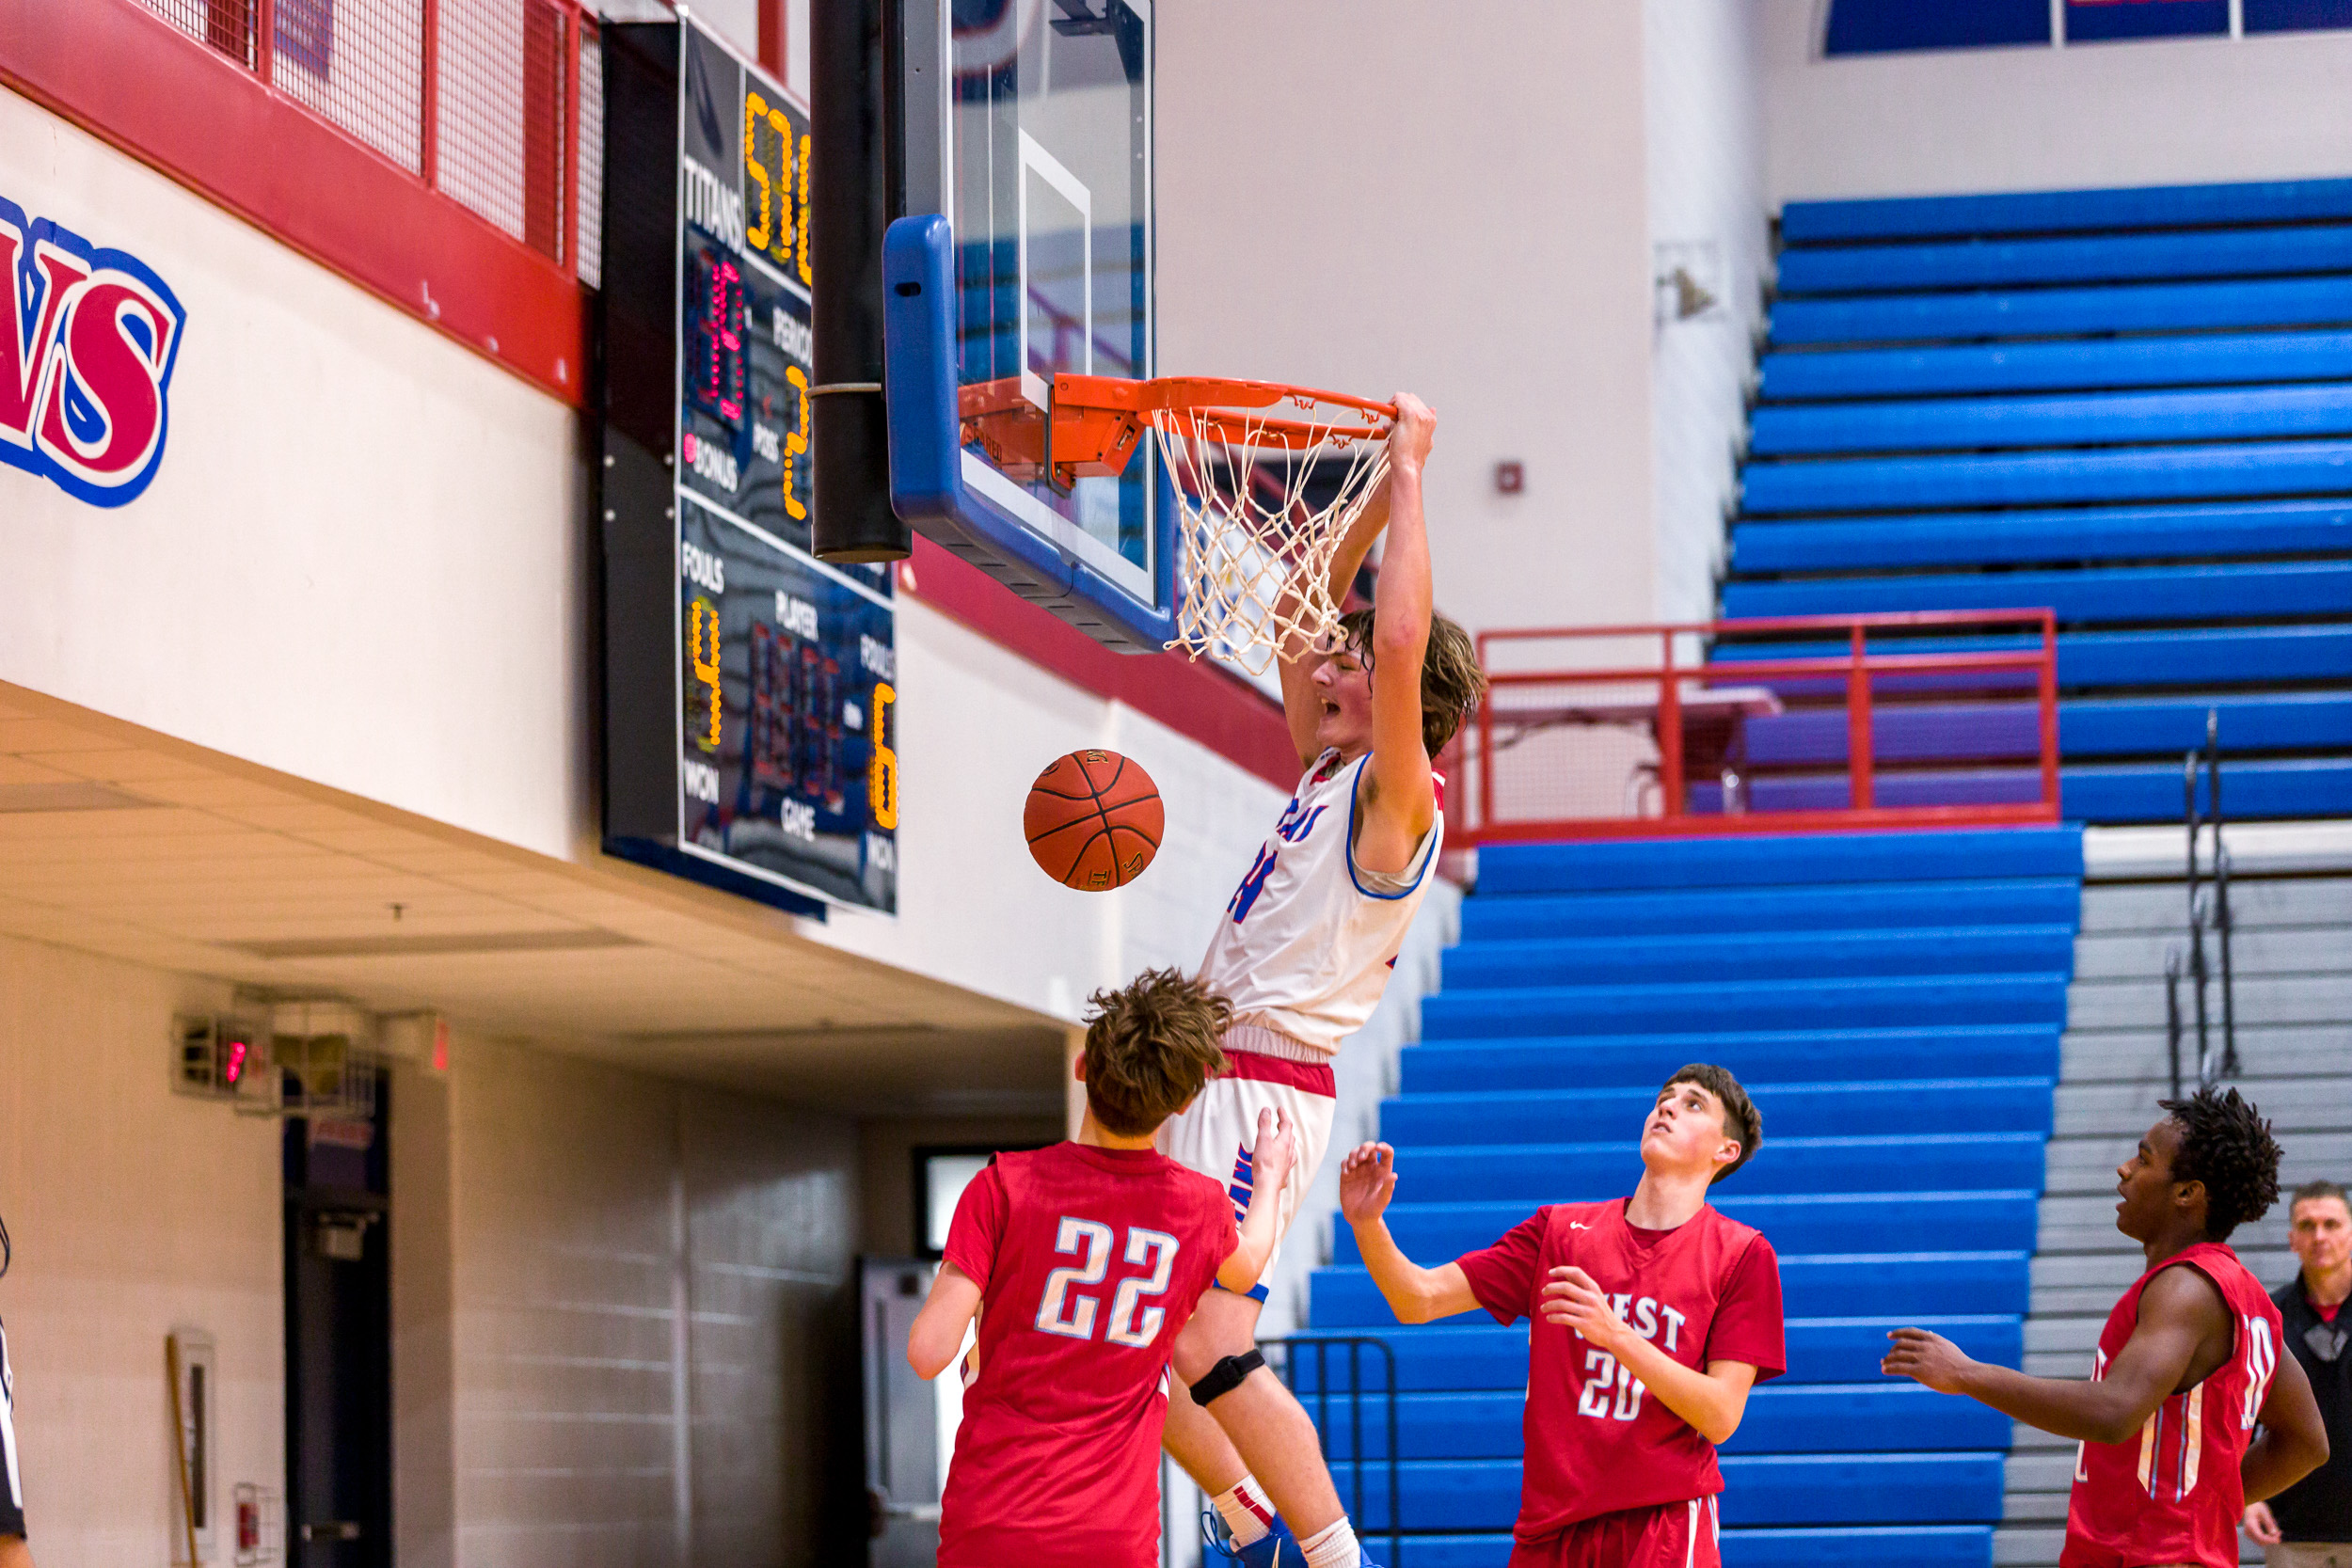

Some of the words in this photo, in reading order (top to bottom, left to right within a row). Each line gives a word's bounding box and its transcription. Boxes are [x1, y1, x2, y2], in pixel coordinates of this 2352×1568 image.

[684, 154, 741, 254] TITANS
[693, 436, 738, 493] BONUS
[783, 365, 808, 520] 2
[682, 541, 725, 594] FOULS
[775, 590, 818, 642] PLAYER
[683, 758, 720, 804] WON
[874, 682, 899, 830] 6
[1033, 1214, 1181, 1349] 22
[1574, 1292, 1686, 1353] EST
[1577, 1348, 1646, 1421] 20
